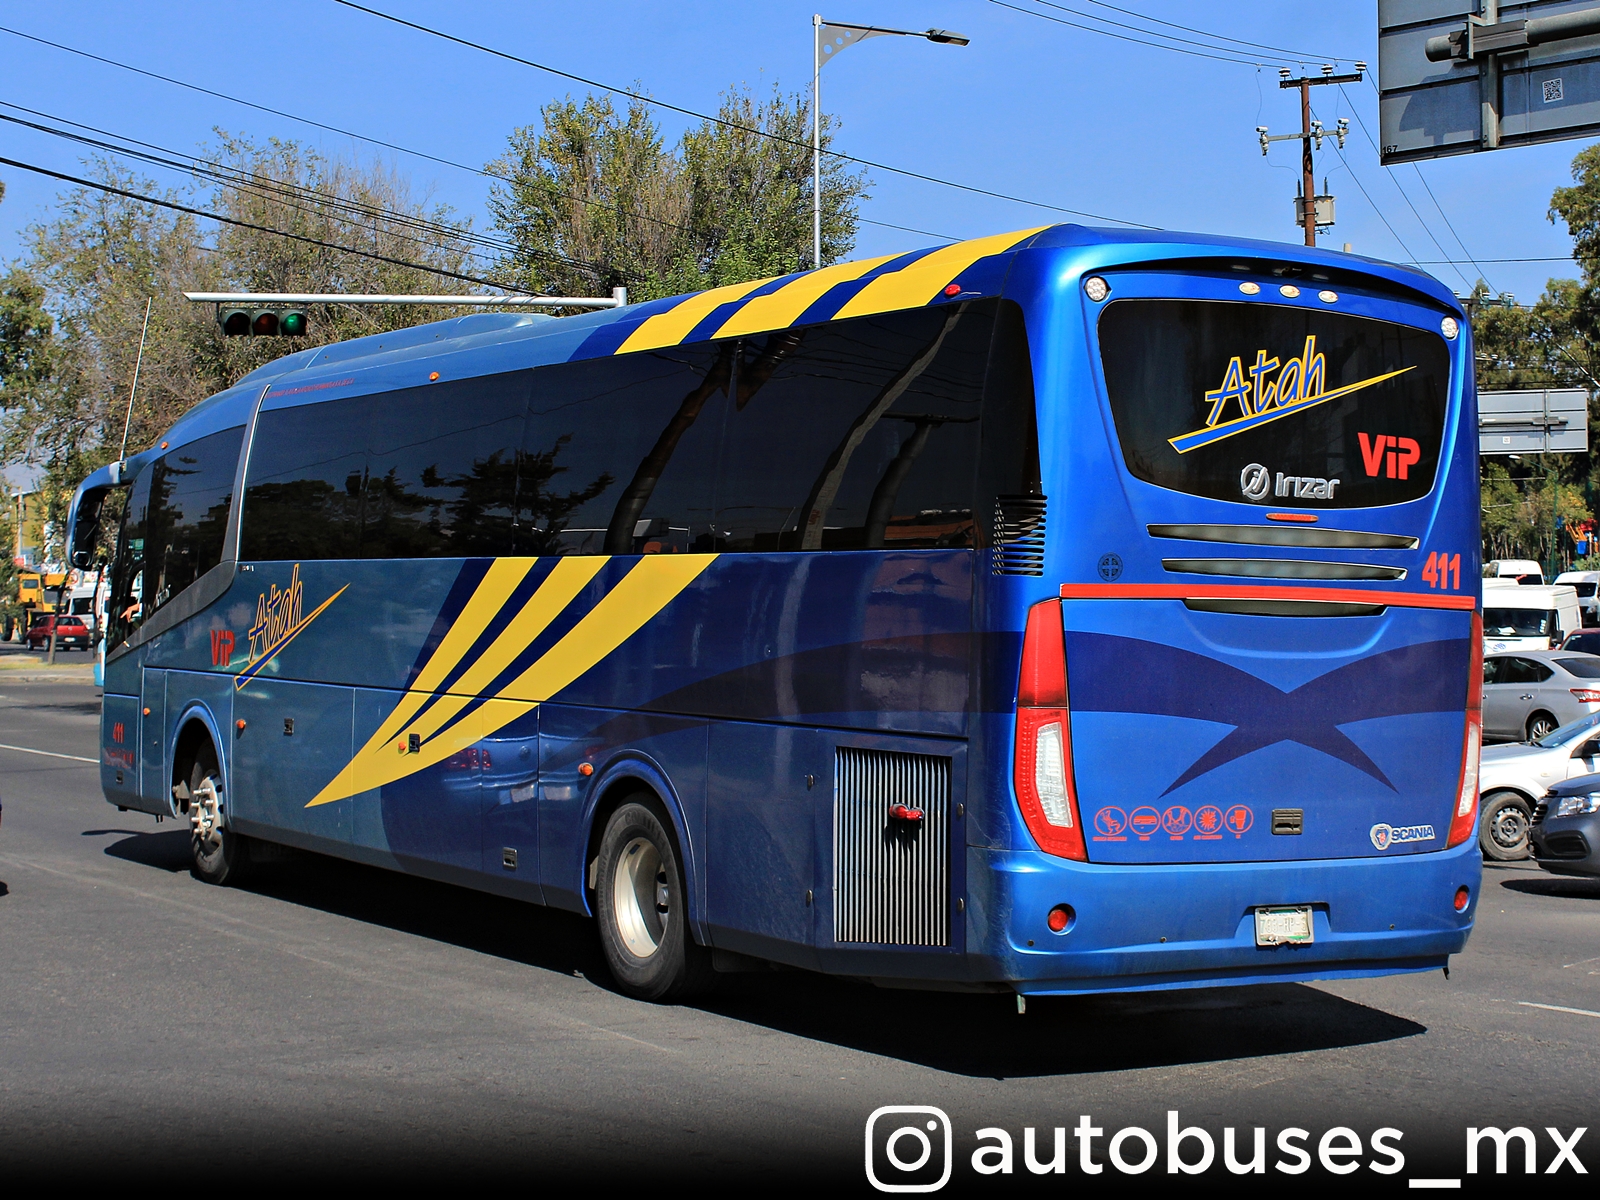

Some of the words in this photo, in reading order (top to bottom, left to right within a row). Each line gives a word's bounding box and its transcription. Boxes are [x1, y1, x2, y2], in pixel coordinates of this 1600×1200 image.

[1205, 334, 1325, 427] Atah
[1422, 551, 1461, 590] 411
[112, 722, 125, 744] 411
[1391, 825, 1435, 842] SCANIA
